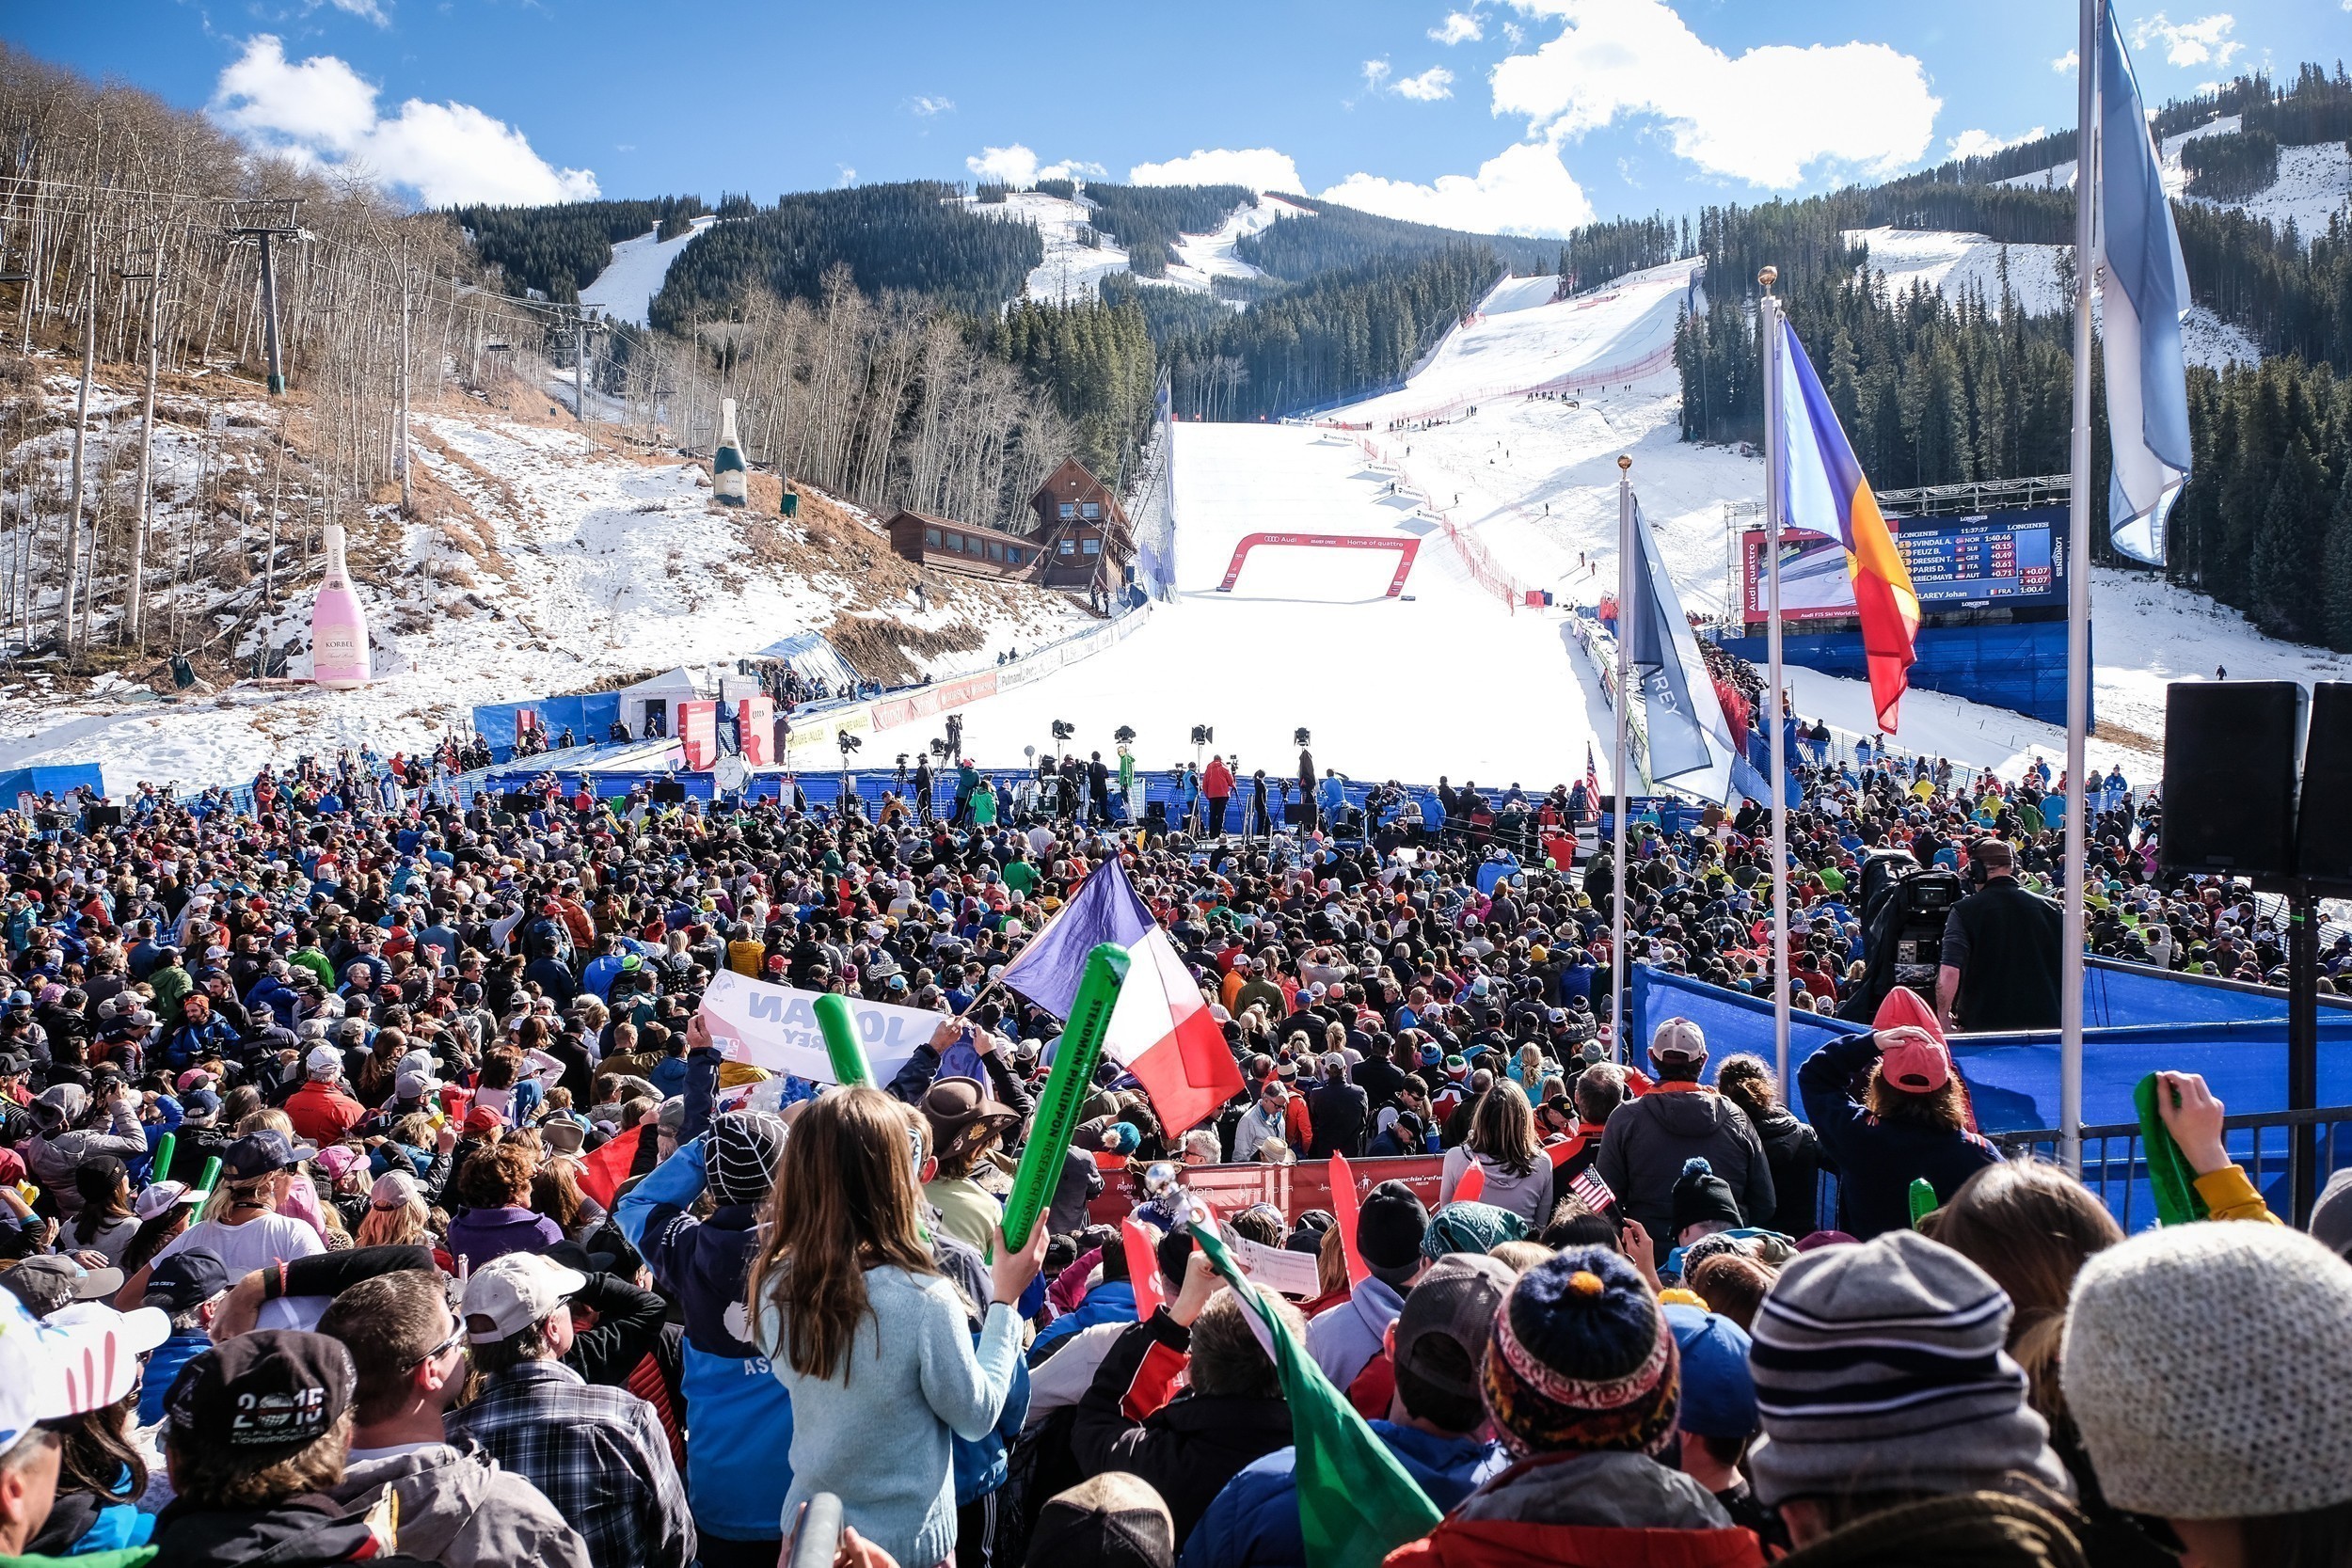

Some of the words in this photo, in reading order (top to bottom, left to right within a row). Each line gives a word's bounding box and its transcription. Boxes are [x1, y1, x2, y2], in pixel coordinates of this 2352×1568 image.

[1899, 531, 1938, 539] LONGINES
[2007, 522, 2049, 531] LONGINES
[1913, 539, 1944, 547] SVINDAL
[1749, 544, 1757, 584] quattro
[1913, 557, 1945, 565] DRESSEN
[1913, 574, 1953, 582] KRIECHMAYR
[879, 705, 906, 725] xfinity
[1073, 998, 1103, 1067] STEADMAN
[1080, 1062, 1089, 1078] AND
[1048, 1069, 1078, 1138] PHILIPPON
[1028, 1141, 1055, 1196] RESEARCH
[1117, 1181, 1135, 1192] Flight
[1009, 1198, 1037, 1253] INSTITUTE
[52, 1288, 73, 1309] HH
